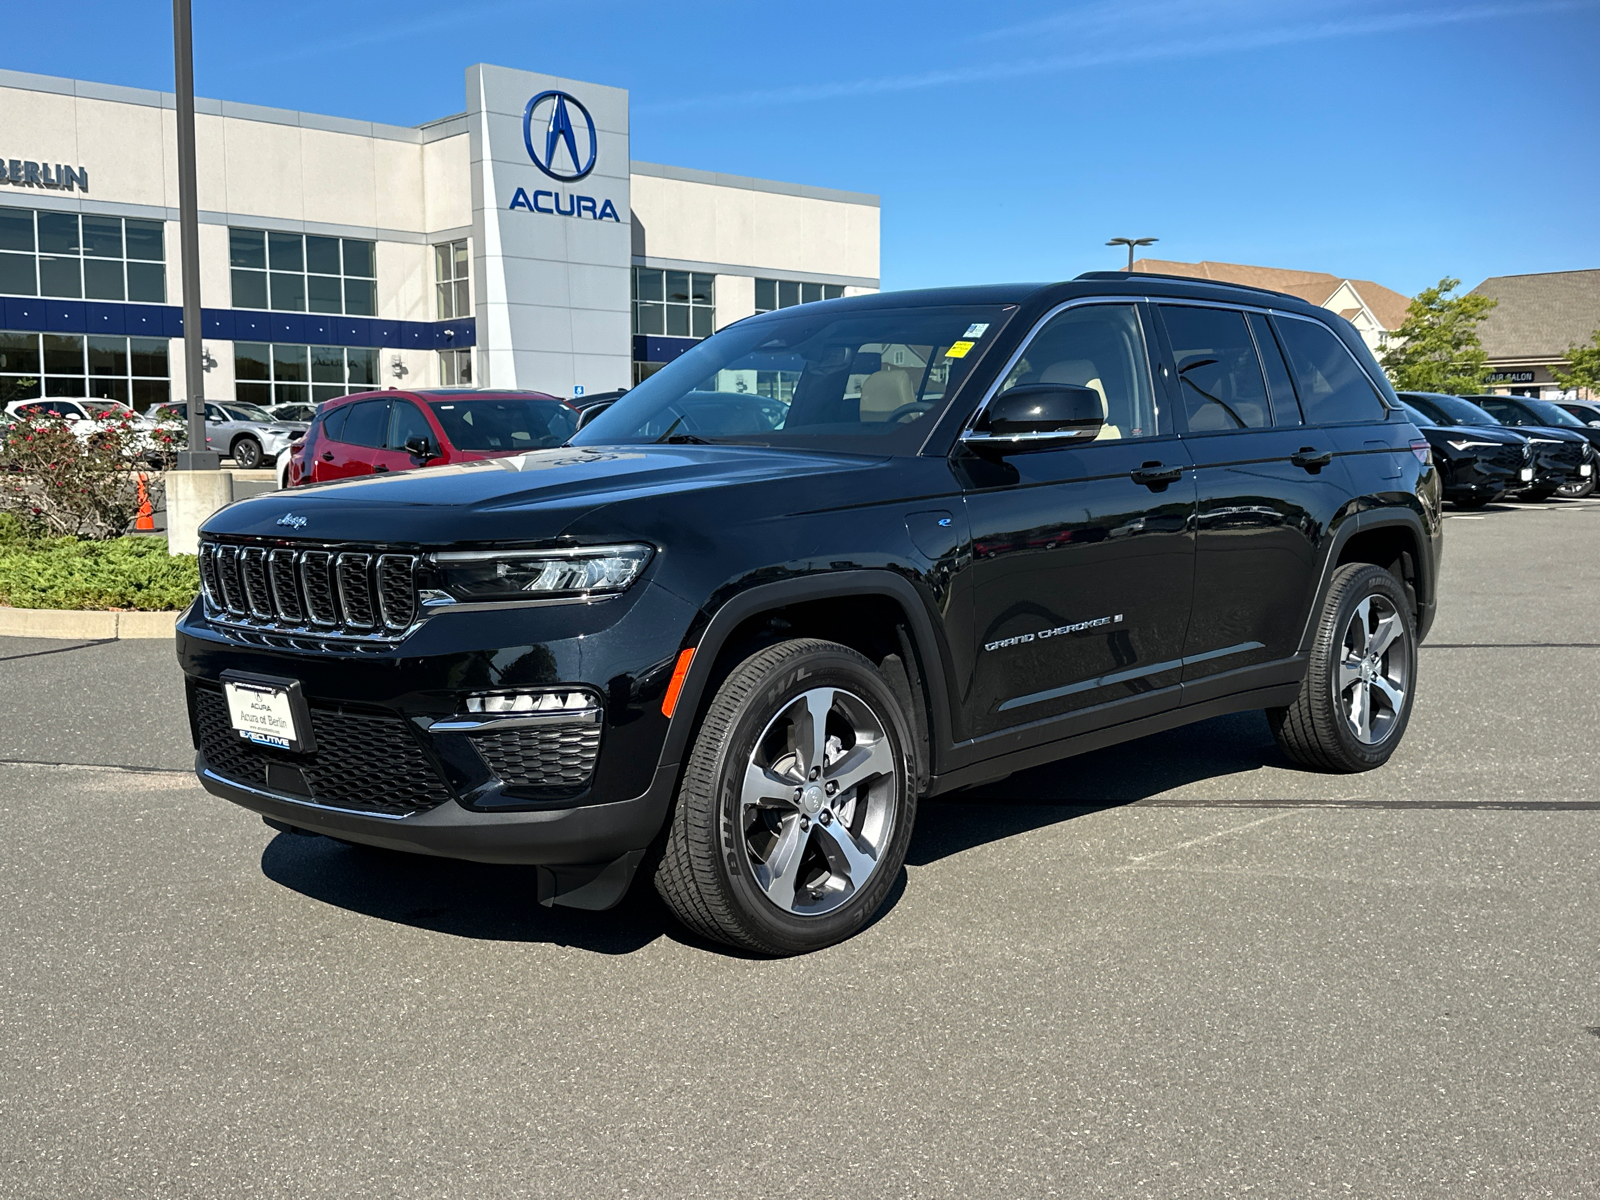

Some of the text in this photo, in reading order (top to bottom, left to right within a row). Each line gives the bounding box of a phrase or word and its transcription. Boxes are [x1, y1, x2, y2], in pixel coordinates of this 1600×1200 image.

[0, 158, 87, 190] BERLIN
[509, 187, 620, 222] ACURA
[276, 512, 307, 530] Jeep
[985, 616, 1111, 651] GRAND CHEROKEE
[251, 702, 272, 712] ACURA
[240, 711, 287, 729] Acura of Berlin
[239, 730, 290, 747] EXECUTIVE
